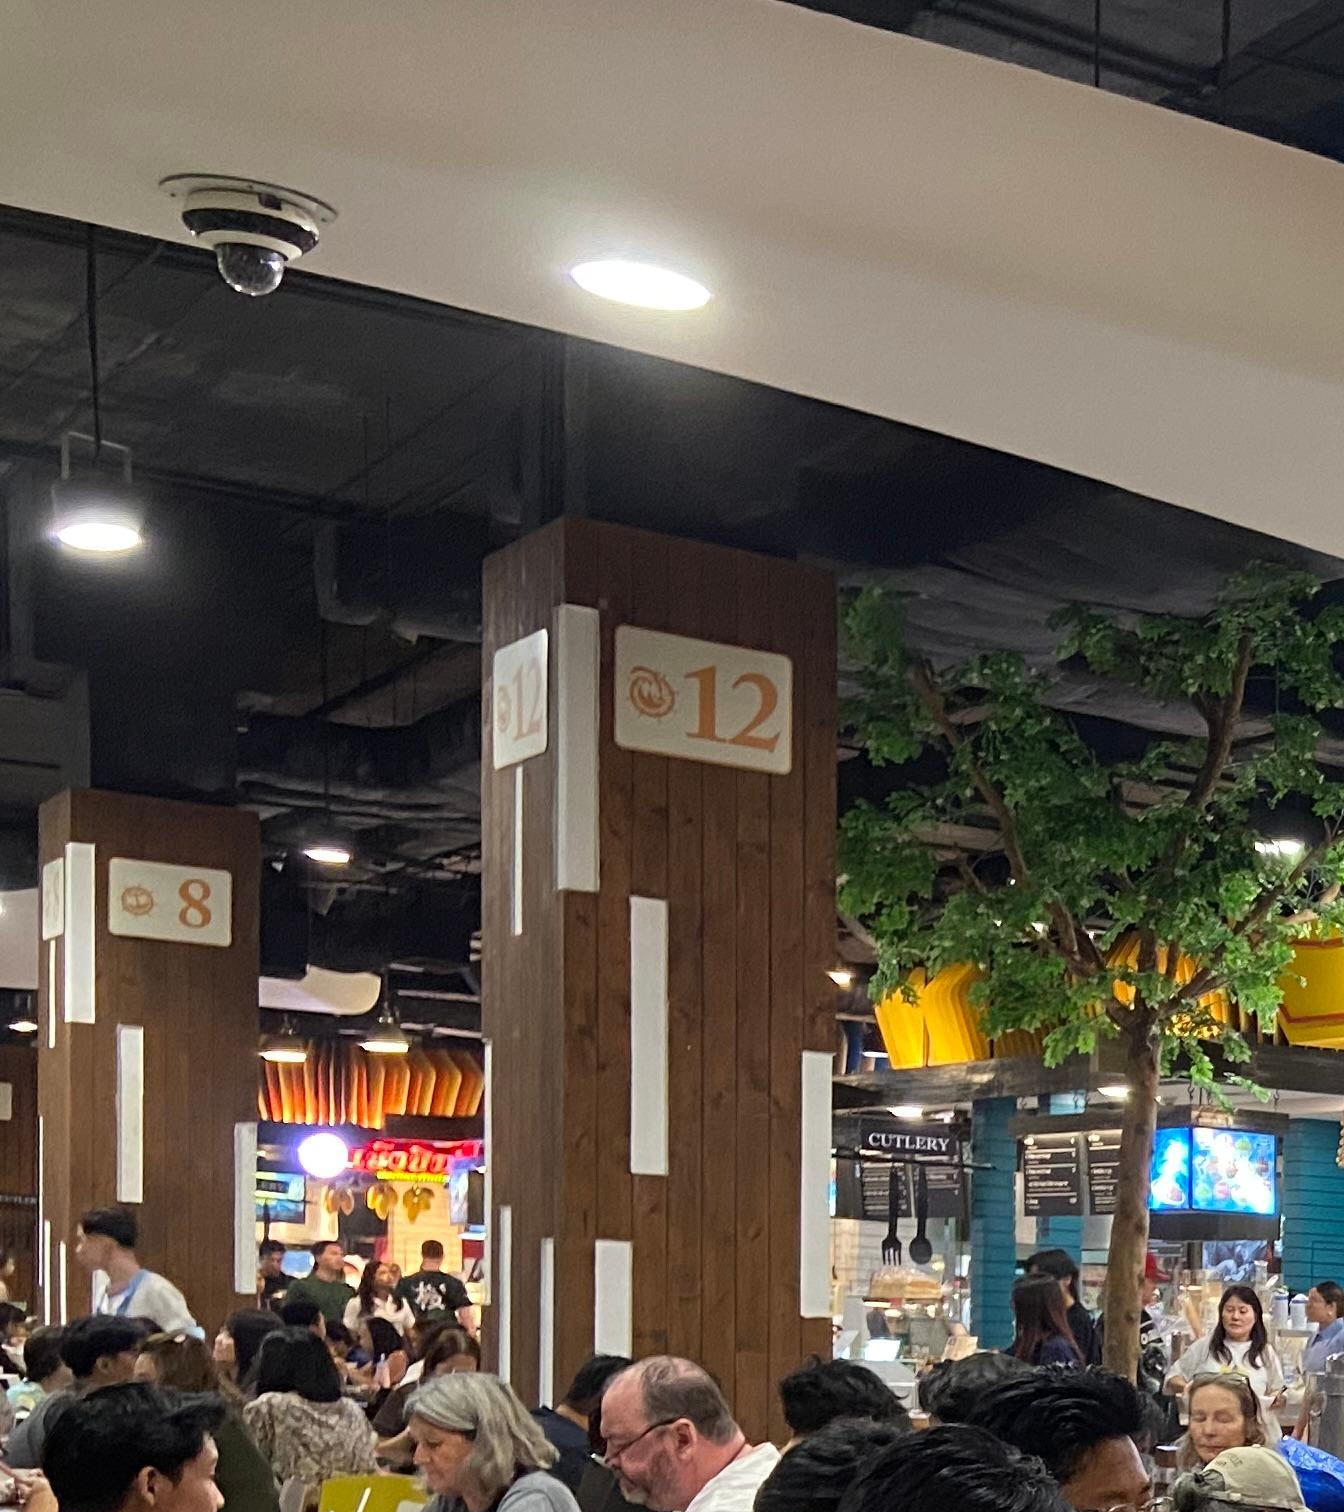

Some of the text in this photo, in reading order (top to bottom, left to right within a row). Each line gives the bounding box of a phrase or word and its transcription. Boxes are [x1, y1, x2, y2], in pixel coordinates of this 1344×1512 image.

[512, 657, 544, 741] 12
[684, 665, 782, 753] 12
[178, 878, 212, 929] 8
[868, 1132, 950, 1152] CUTLERY
